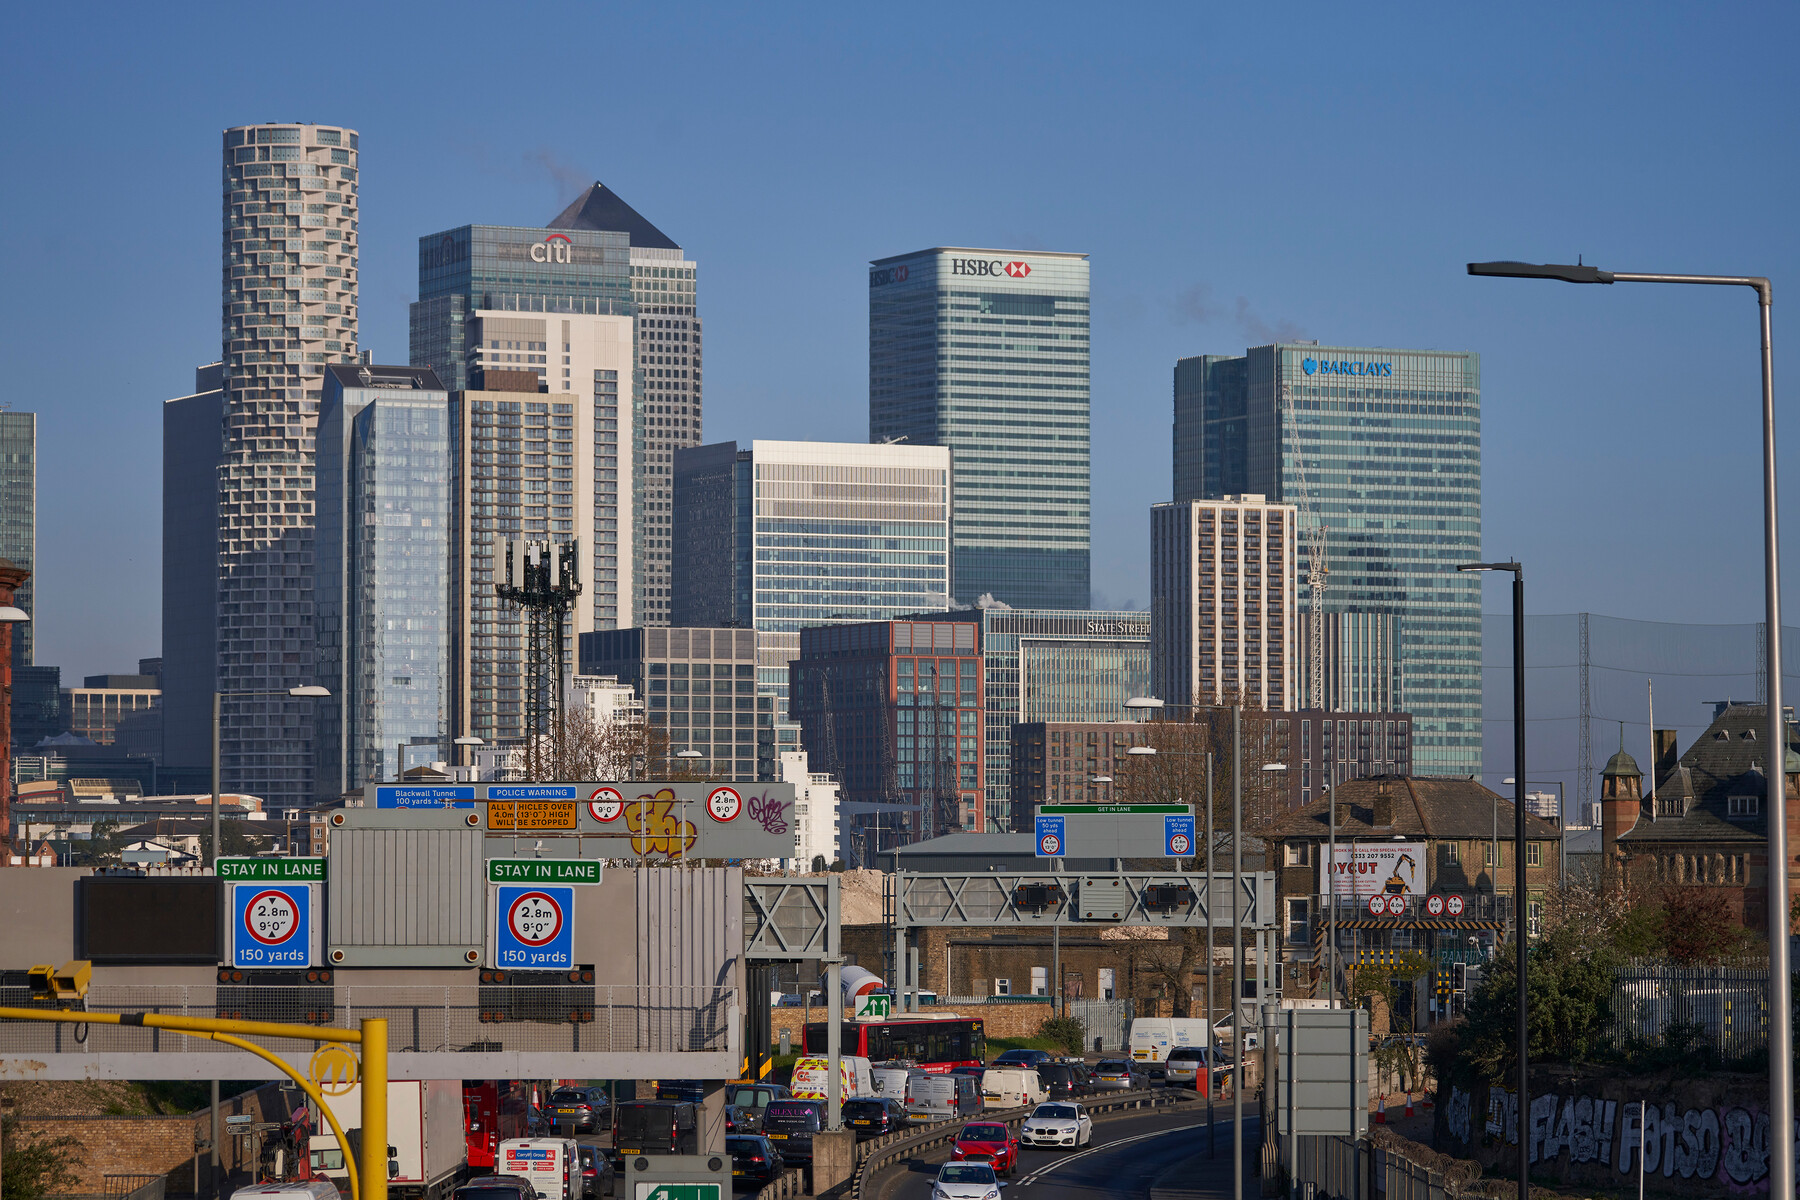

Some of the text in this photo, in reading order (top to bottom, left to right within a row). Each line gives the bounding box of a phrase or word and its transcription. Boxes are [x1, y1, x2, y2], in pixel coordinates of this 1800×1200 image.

[530, 238, 571, 264] citi
[952, 258, 1003, 277] HSBC
[1321, 360, 1392, 377] BARCLAYS
[1088, 621, 1116, 633] STATE
[395, 789, 456, 797] Blackwall Tunnel
[412, 797, 432, 805] yards
[715, 796, 736, 804] 2.8m
[221, 863, 322, 875] STAY IN LANE
[494, 864, 595, 878] STAY IN LANE
[257, 905, 289, 917] 2.8m
[521, 906, 552, 918] 2.8m
[240, 949, 304, 963] 150 yards
[502, 950, 567, 964] 150 yards
[770, 1108, 793, 1116] SILEX
